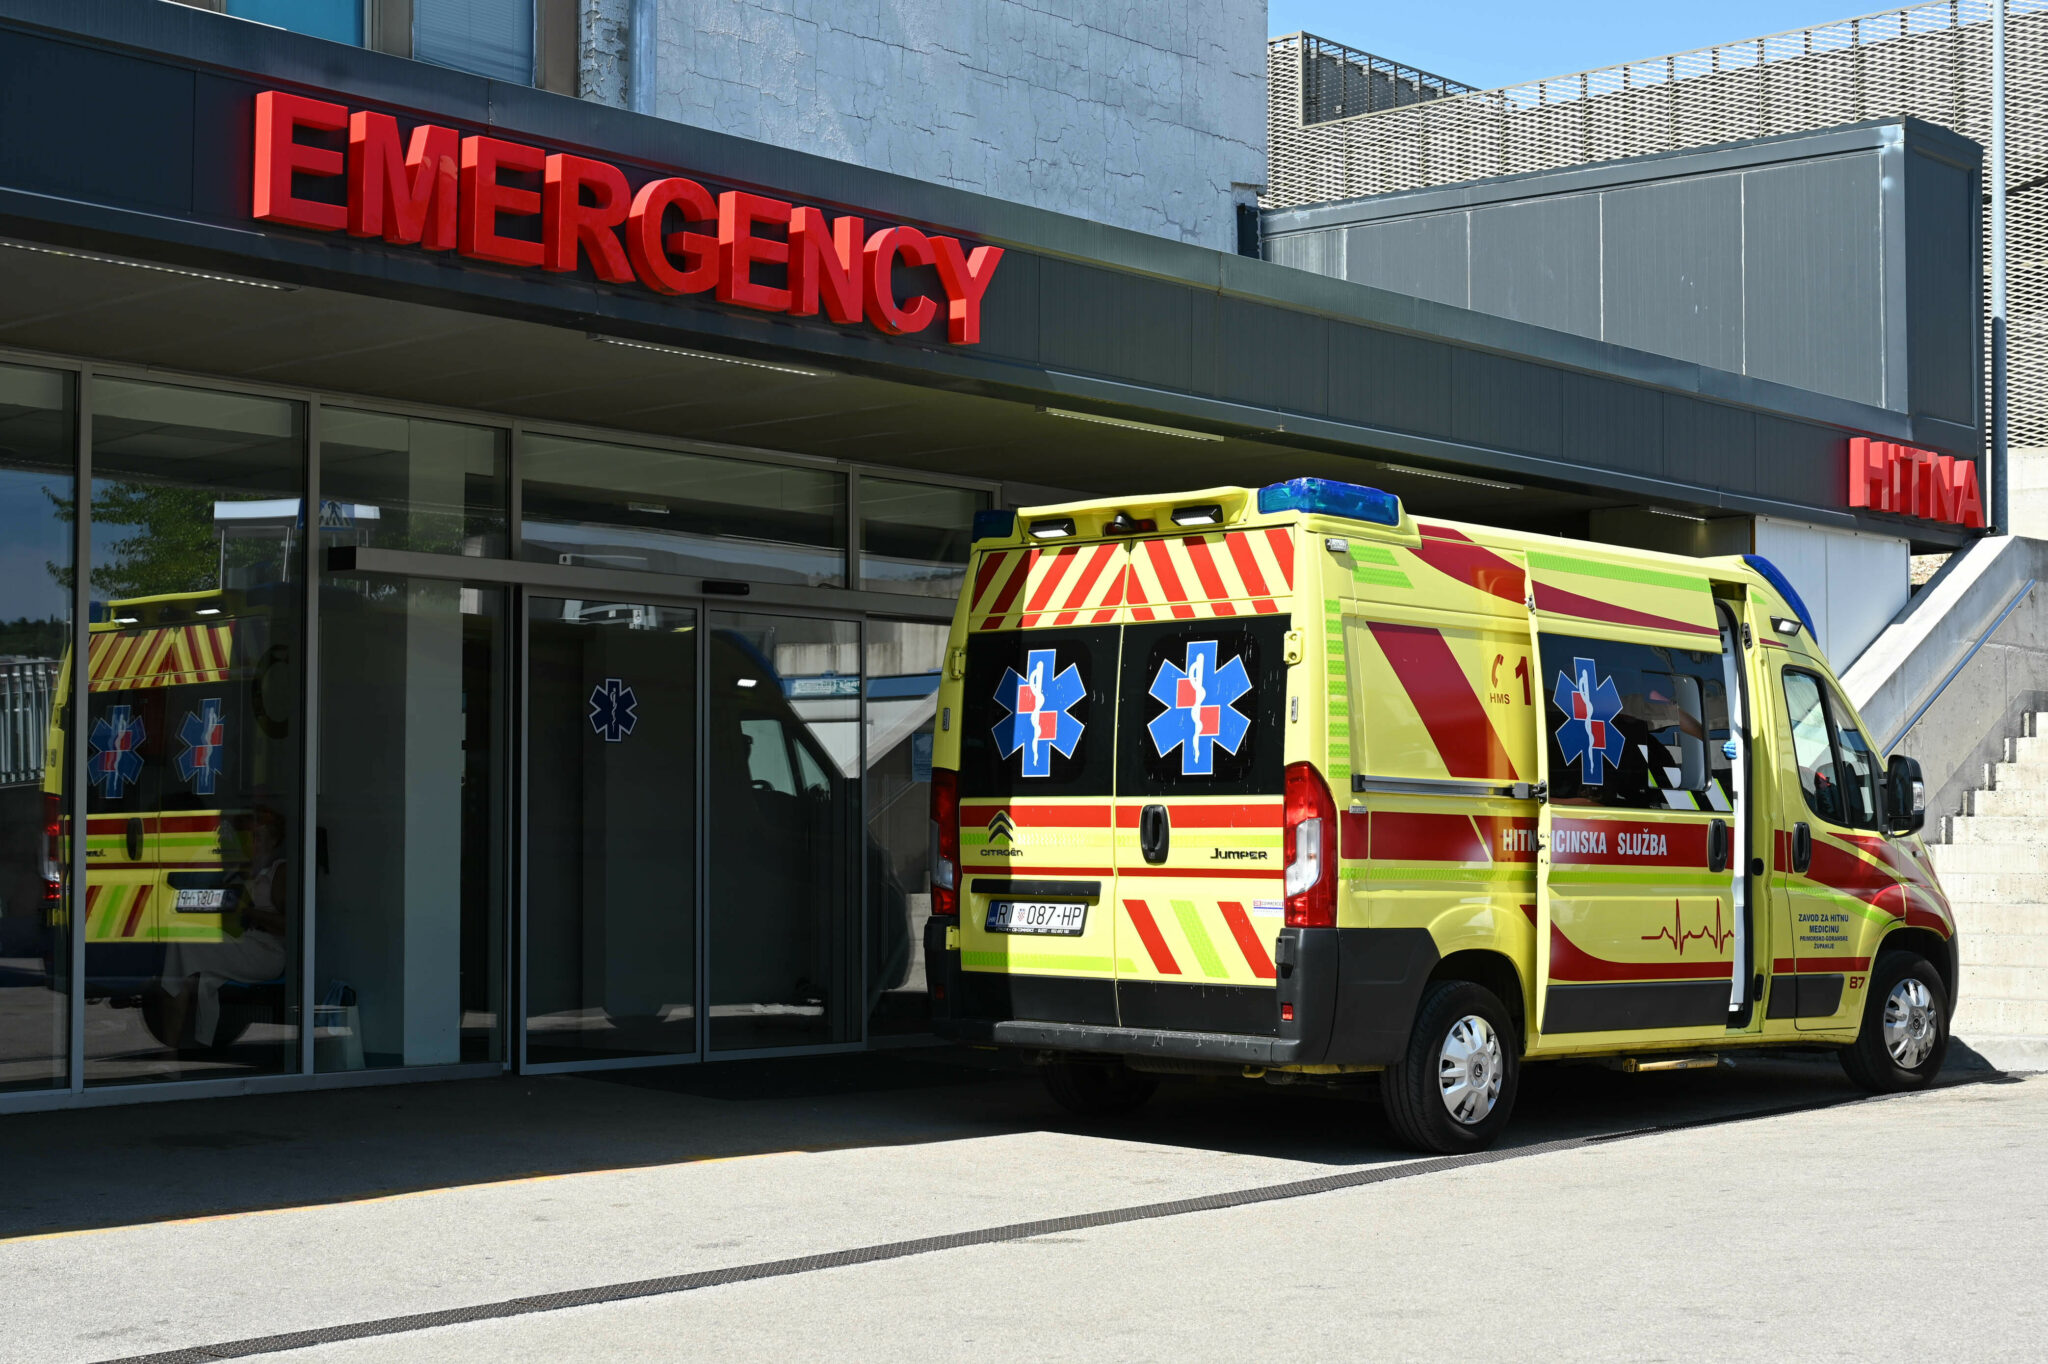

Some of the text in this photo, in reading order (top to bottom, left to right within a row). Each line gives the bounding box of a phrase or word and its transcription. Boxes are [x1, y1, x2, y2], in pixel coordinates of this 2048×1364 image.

[253, 91, 1004, 345] EMERGENCY
[1849, 437, 1986, 528] HITNA
[1514, 655, 1535, 706] 1
[1489, 693, 1511, 705] HMS
[1617, 828, 1668, 857] SLUŽBA
[997, 904, 1082, 926] RI 087-HP
[1798, 914, 1849, 922] ZAVOD ZA HITNU
[1809, 925, 1839, 933] MEDICINU
[1849, 976, 1865, 989] 87
